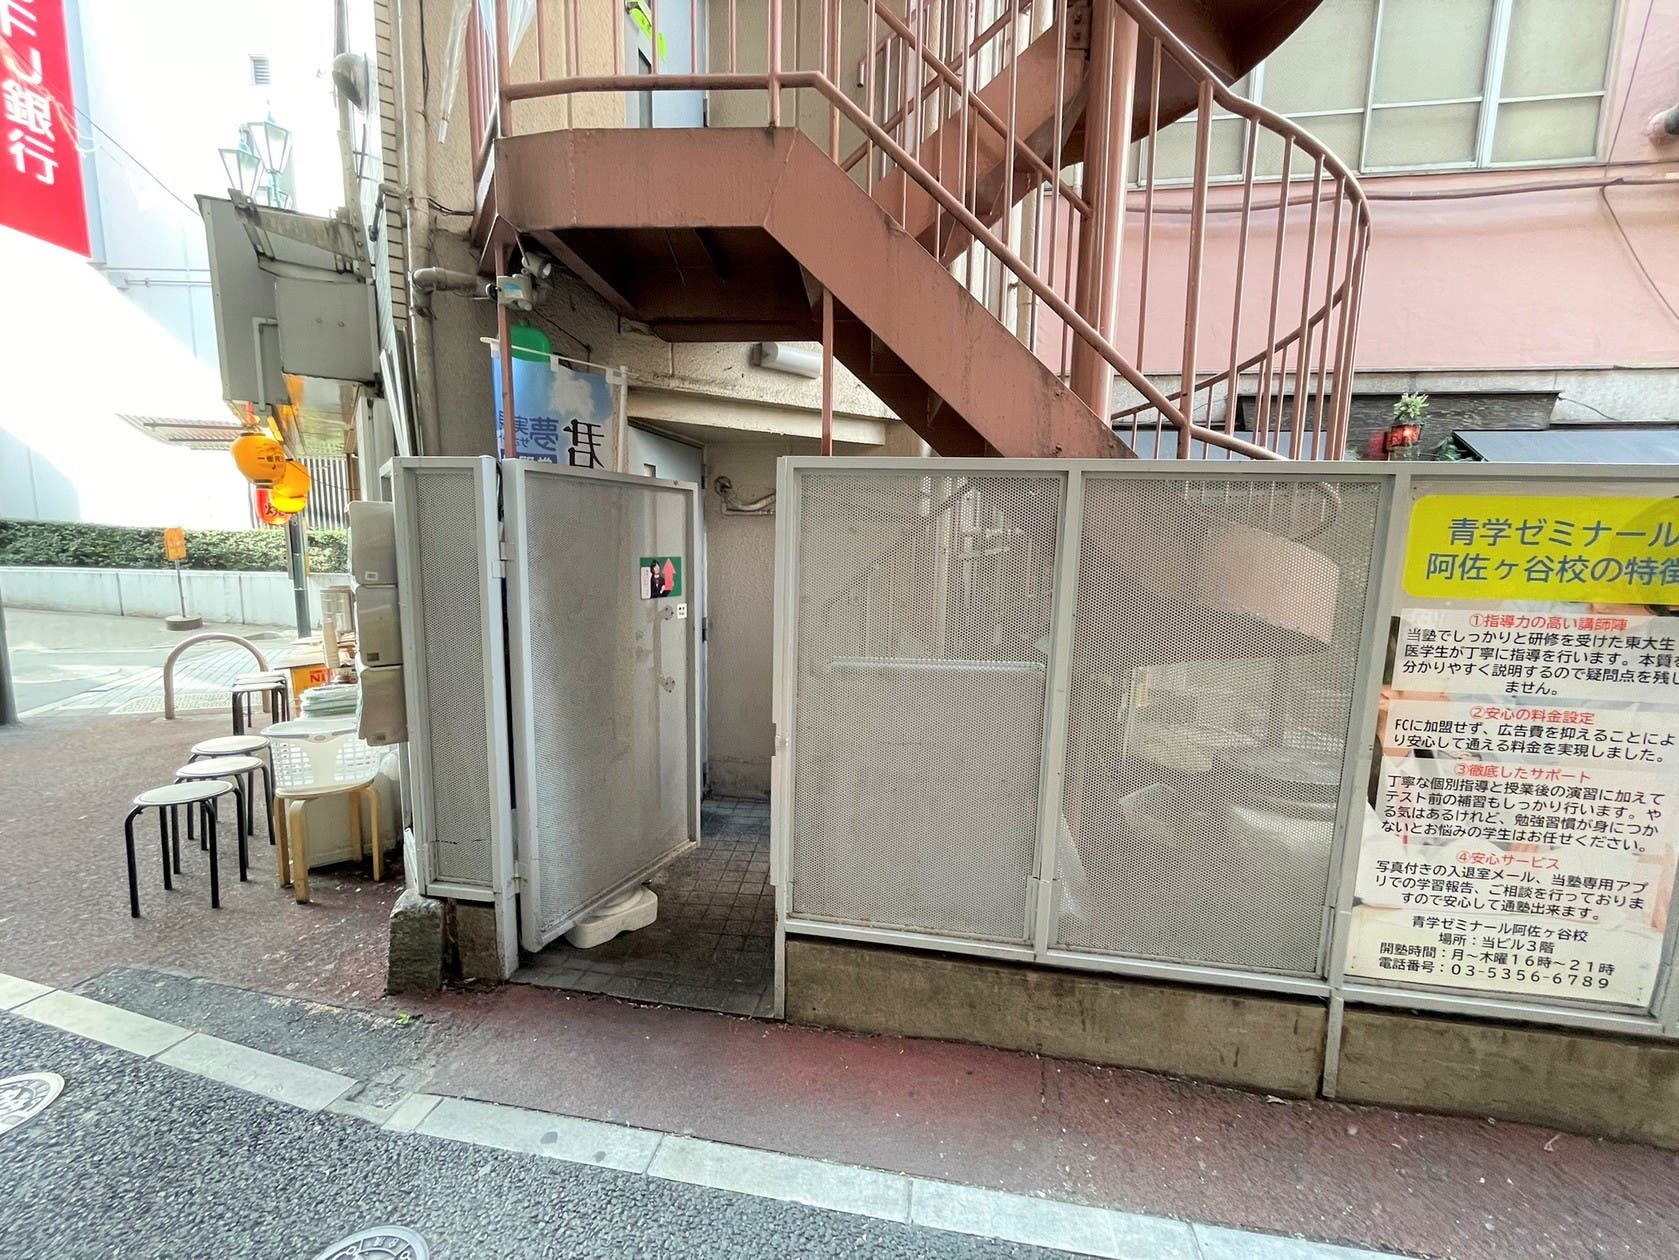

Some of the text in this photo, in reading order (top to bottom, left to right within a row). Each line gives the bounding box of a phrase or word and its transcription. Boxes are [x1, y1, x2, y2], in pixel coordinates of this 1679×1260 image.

[1448, 517, 1679, 548] 青学ゼミナール
[1407, 627, 1675, 651] 当塾でしっかりと研修を受けた東大生
[1505, 681, 1558, 696] ません。
[1394, 734, 1664, 763] り安心して通える料金を実現しました。
[1456, 850, 1559, 870] ④安心サービス
[1401, 892, 1598, 921] すので安心して通塾出来ます。
